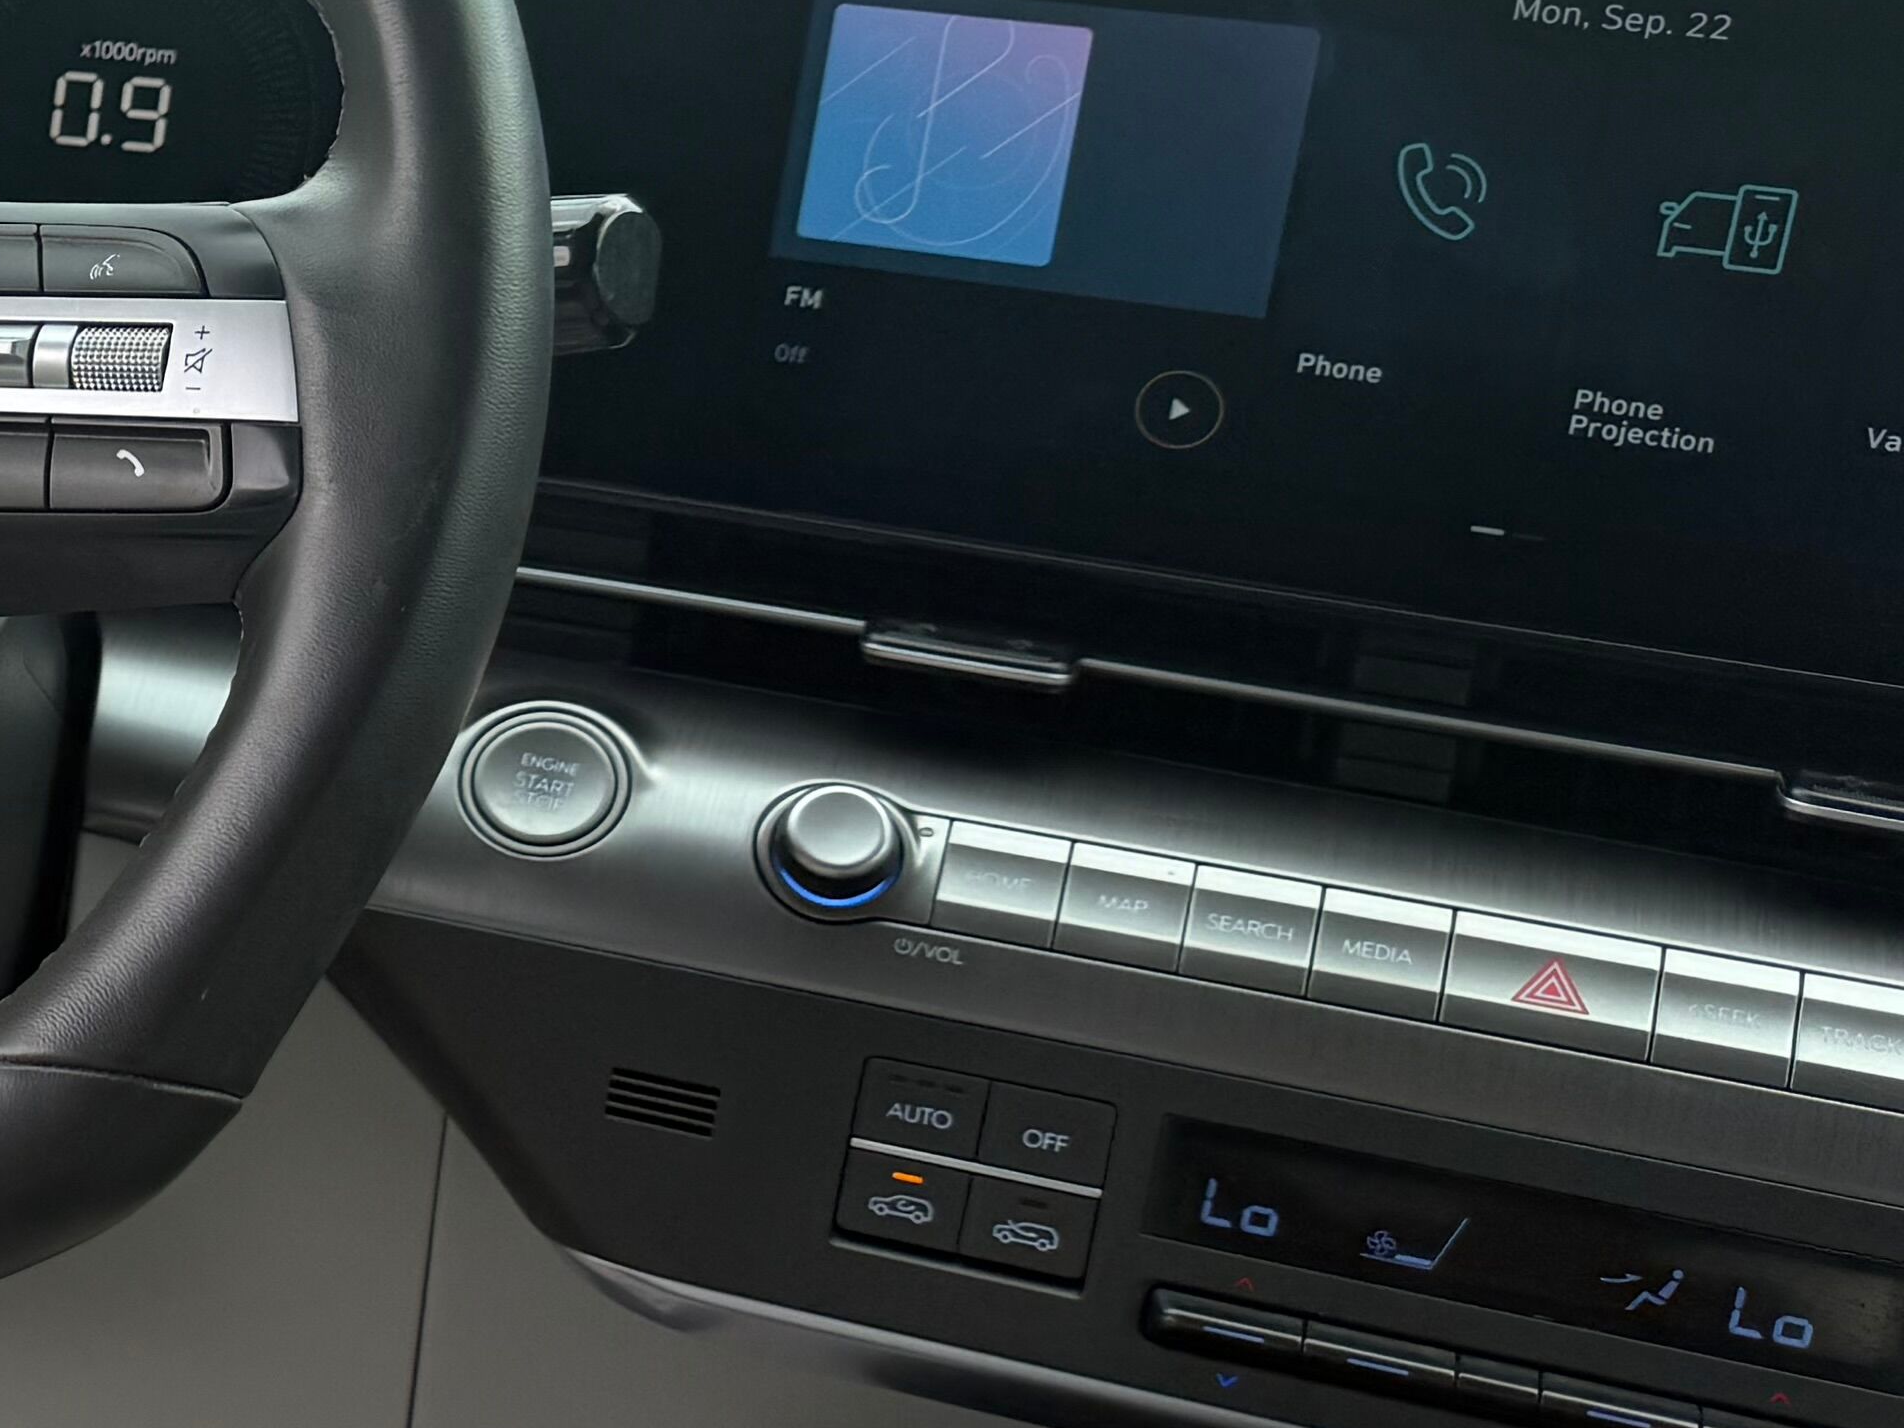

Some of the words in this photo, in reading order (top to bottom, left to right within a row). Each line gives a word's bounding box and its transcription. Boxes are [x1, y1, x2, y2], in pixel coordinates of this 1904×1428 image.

[1601, 4, 1673, 39] Sep.
[1685, 12, 1733, 40] 22
[80, 39, 177, 66] x1000rpm
[49, 71, 171, 153] 0.9
[783, 285, 824, 309] FM
[1296, 353, 1382, 384] Phone
[1574, 388, 1664, 420] Phone
[1567, 414, 1716, 454] Projection
[520, 752, 581, 776] ENGINE
[512, 771, 575, 797] START
[1206, 912, 1294, 942] SEARCH
[1342, 938, 1413, 966] MEDIA
[886, 1103, 952, 1129] AUTO
[1022, 1129, 1070, 1153] OFF
[1200, 1178, 1279, 1238] Lo
[1729, 1287, 1814, 1350] Lo
